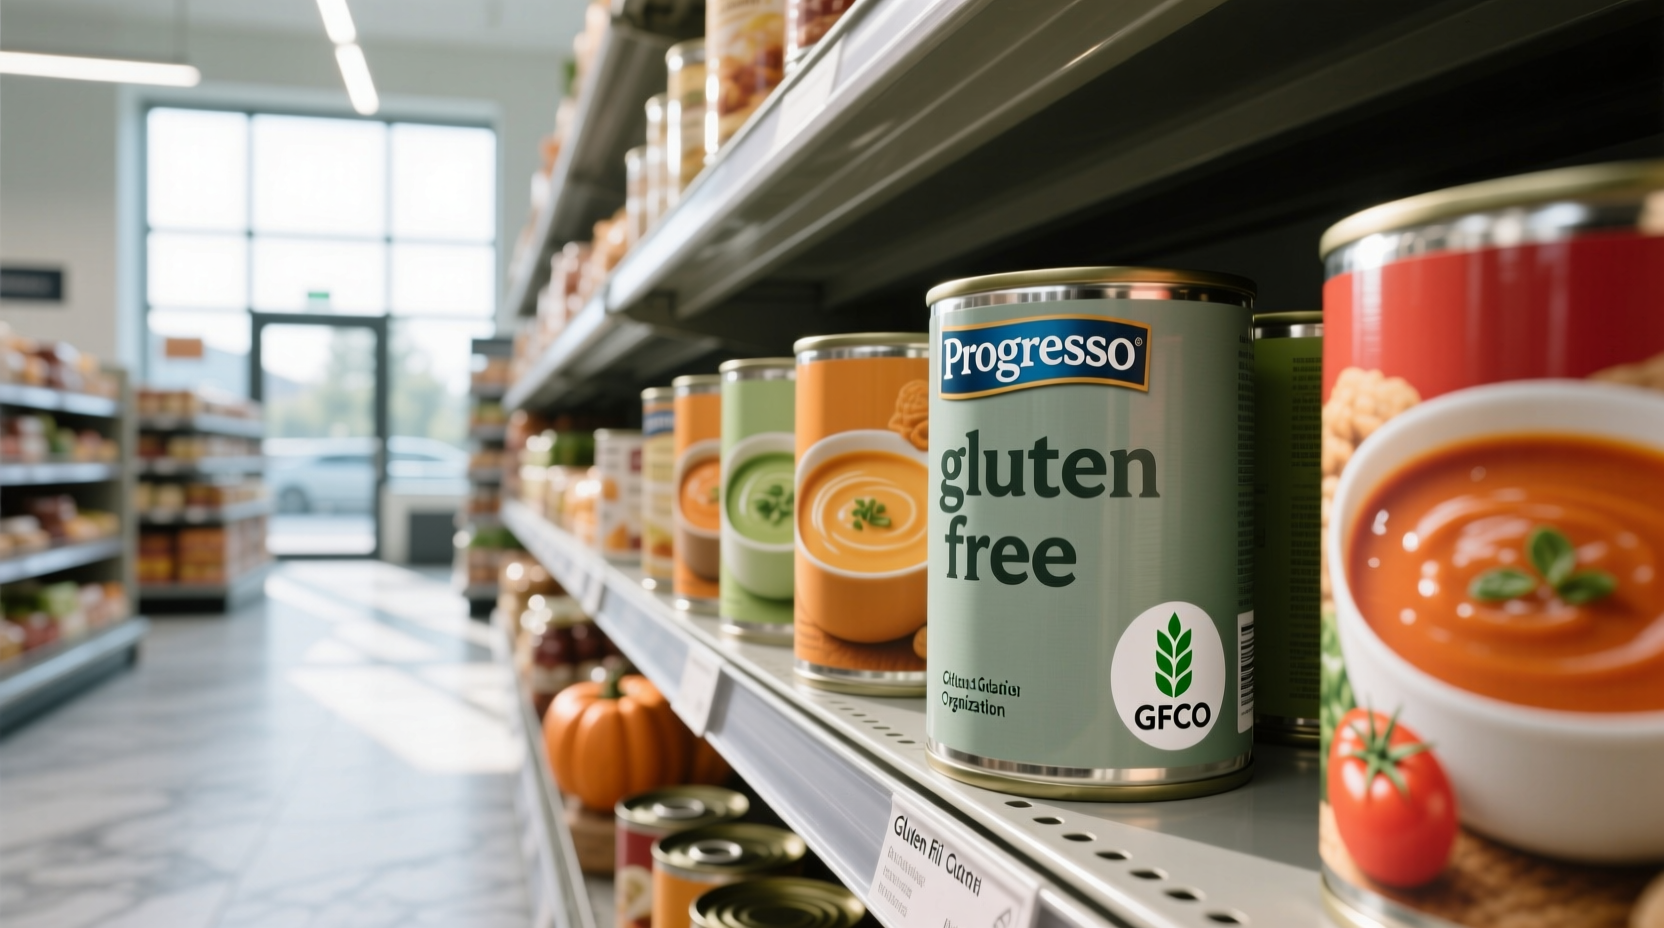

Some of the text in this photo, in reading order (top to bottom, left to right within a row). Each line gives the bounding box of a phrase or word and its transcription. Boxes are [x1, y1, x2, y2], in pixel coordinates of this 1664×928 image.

[943, 334, 1136, 383] Progresso
[939, 429, 1161, 514] gluten
[944, 515, 1077, 588] free
[1134, 702, 1211, 730] GFCO
